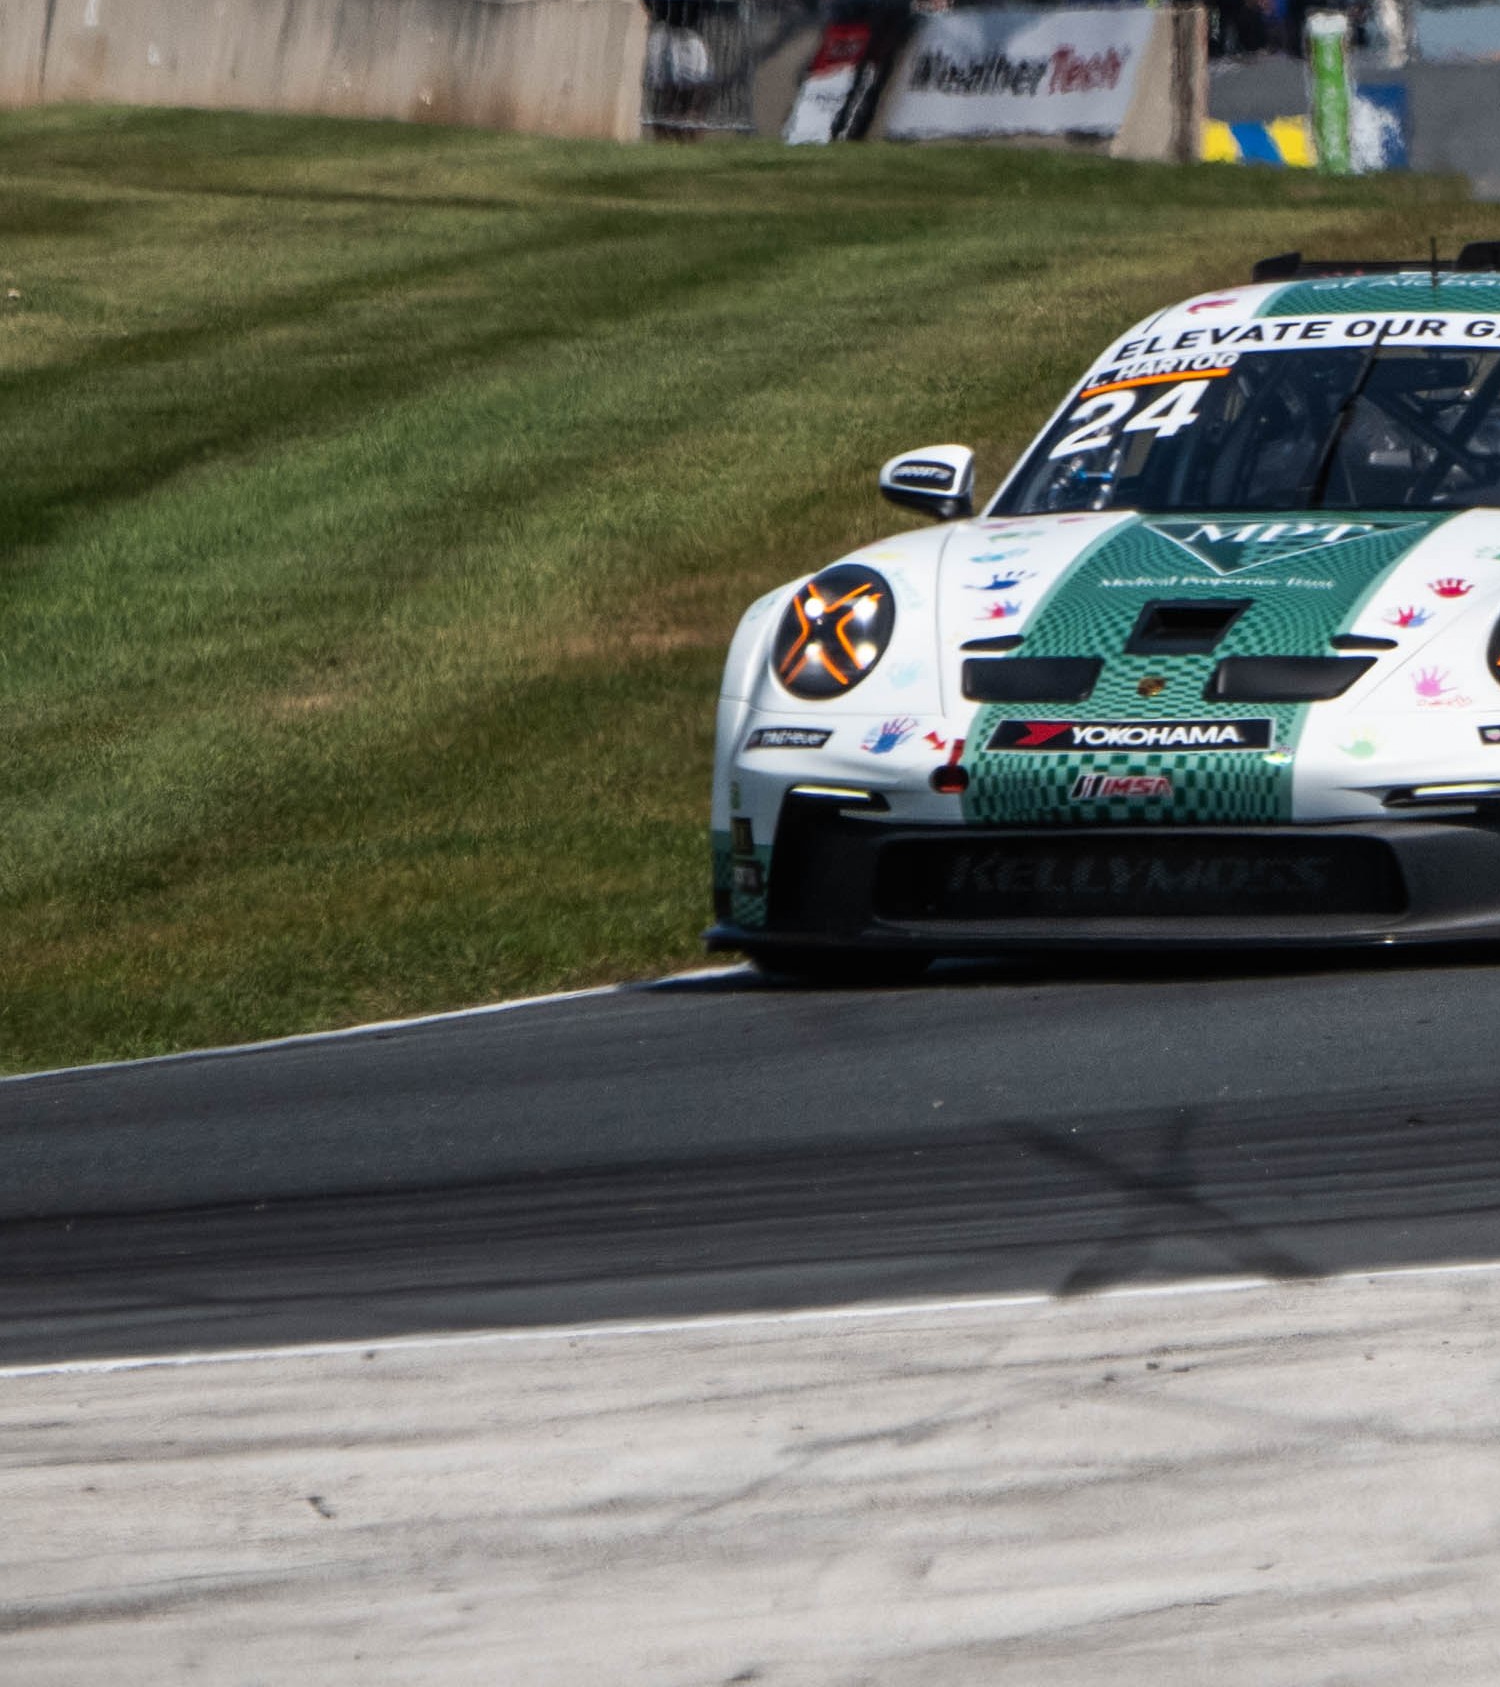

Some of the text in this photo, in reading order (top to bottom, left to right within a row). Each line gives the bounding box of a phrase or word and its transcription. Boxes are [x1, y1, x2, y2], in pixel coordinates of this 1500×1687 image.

[1112, 320, 1333, 363] ELEVATE
[1344, 319, 1448, 339] OUR
[1115, 350, 1241, 382] HARTOG
[1049, 380, 1210, 459] 24
[1183, 523, 1377, 544] MPT
[1070, 725, 1244, 746] YOKOHAMA
[1101, 775, 1174, 797] IMSA
[946, 852, 1337, 895] KELLYMOSS
